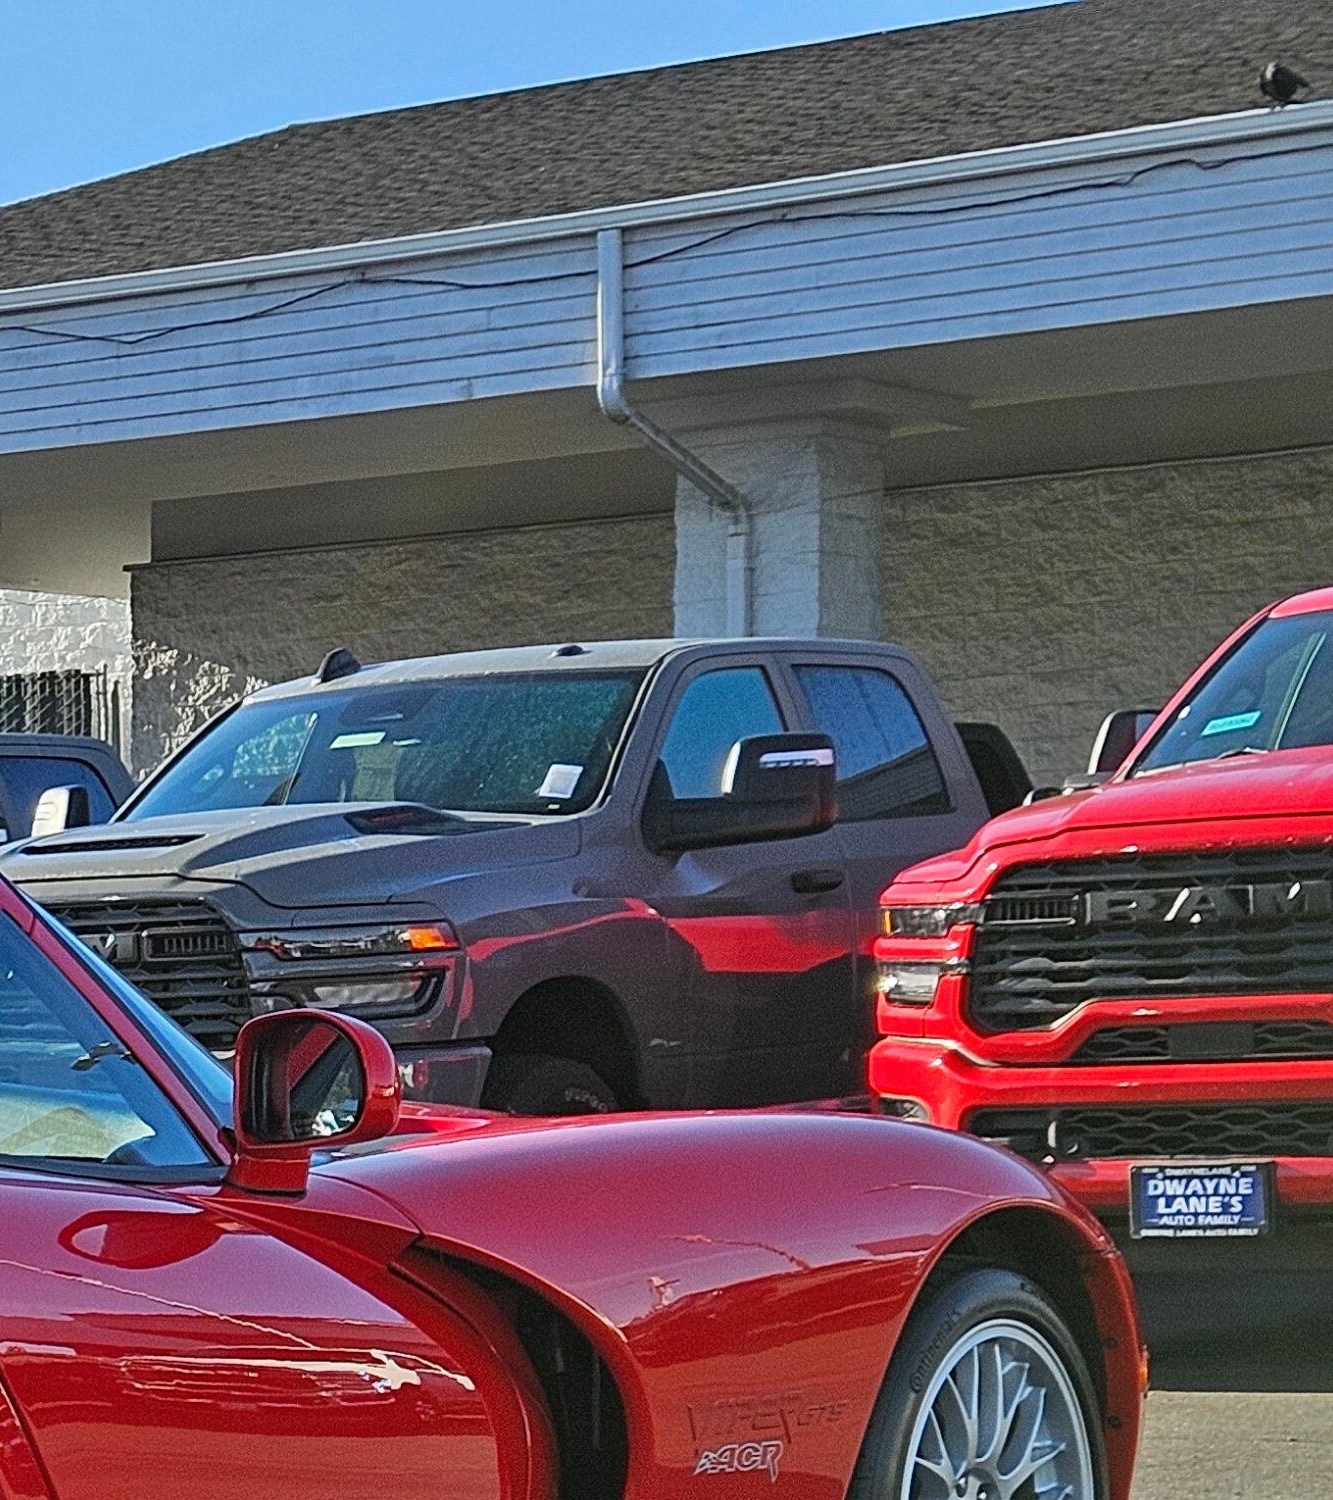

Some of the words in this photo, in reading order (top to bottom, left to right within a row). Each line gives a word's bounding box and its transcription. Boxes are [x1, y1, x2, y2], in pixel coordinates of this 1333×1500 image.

[1084, 881, 1331, 925] RAM
[1147, 1178, 1253, 1196] DWAYNE
[1157, 1195, 1243, 1213] LANE'S
[1158, 1215, 1195, 1225] AUTO
[1198, 1214, 1242, 1225] FAMILY
[707, 1439, 784, 1484] ACR
